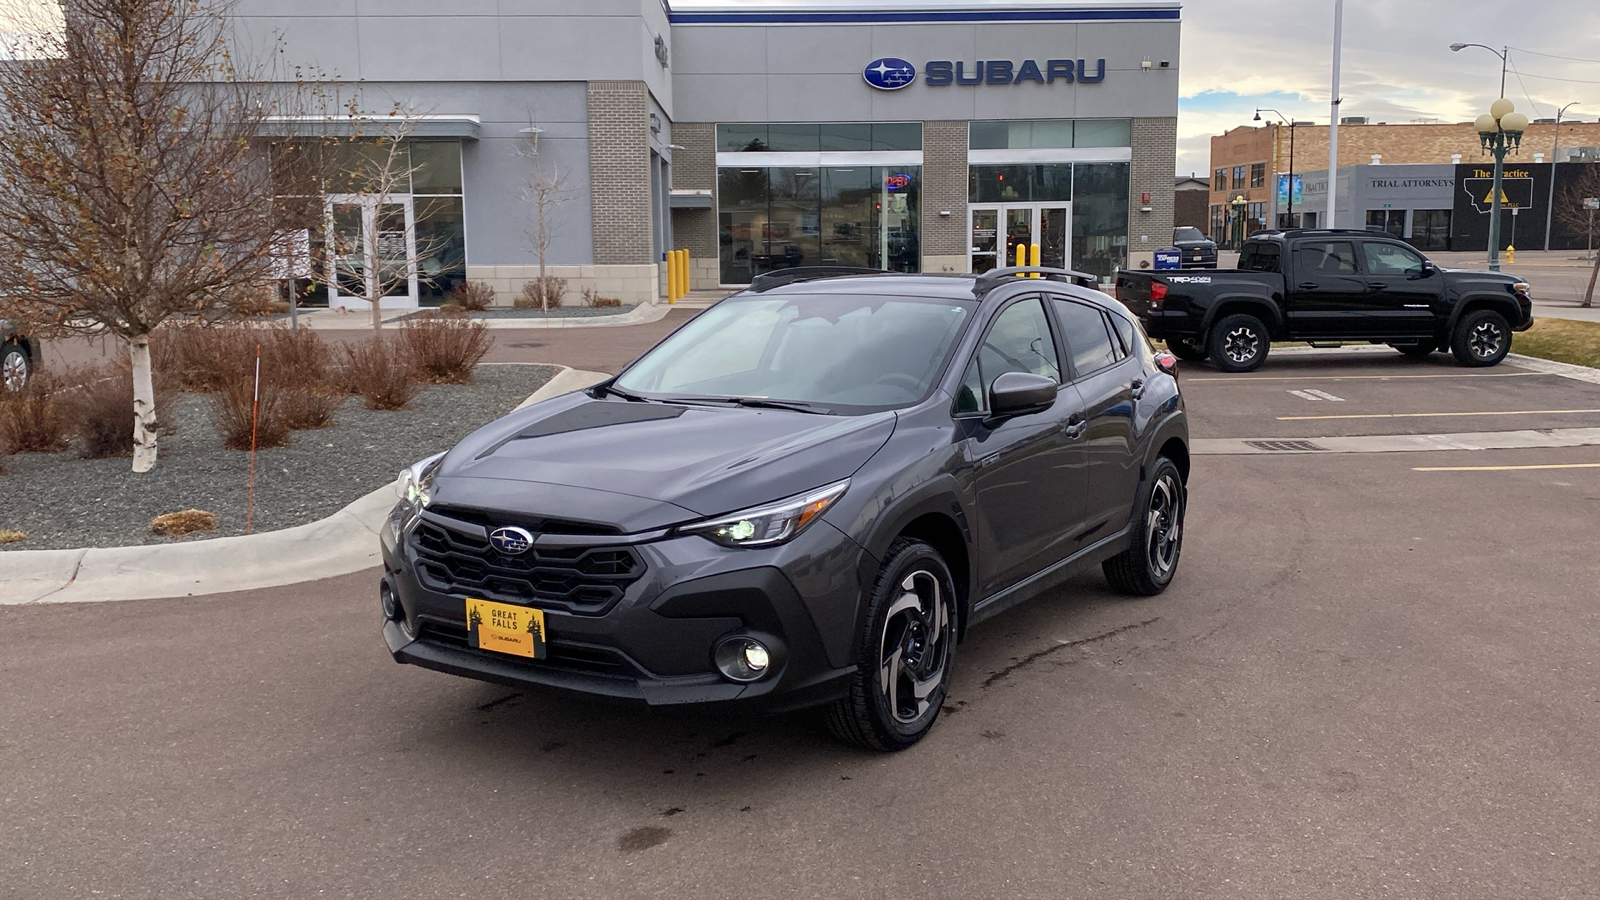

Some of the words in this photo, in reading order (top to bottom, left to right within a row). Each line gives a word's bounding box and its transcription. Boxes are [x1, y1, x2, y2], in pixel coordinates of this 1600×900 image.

[925, 59, 1106, 86] SUBARU
[1473, 169, 1490, 178] The
[1494, 169, 1529, 178] ractice
[1371, 179, 1399, 188] TRIAL
[1401, 179, 1454, 188] ATTORNEYS
[491, 609, 517, 620] GREAT
[492, 618, 518, 630] FALLS
[498, 635, 521, 643] SUBARU
